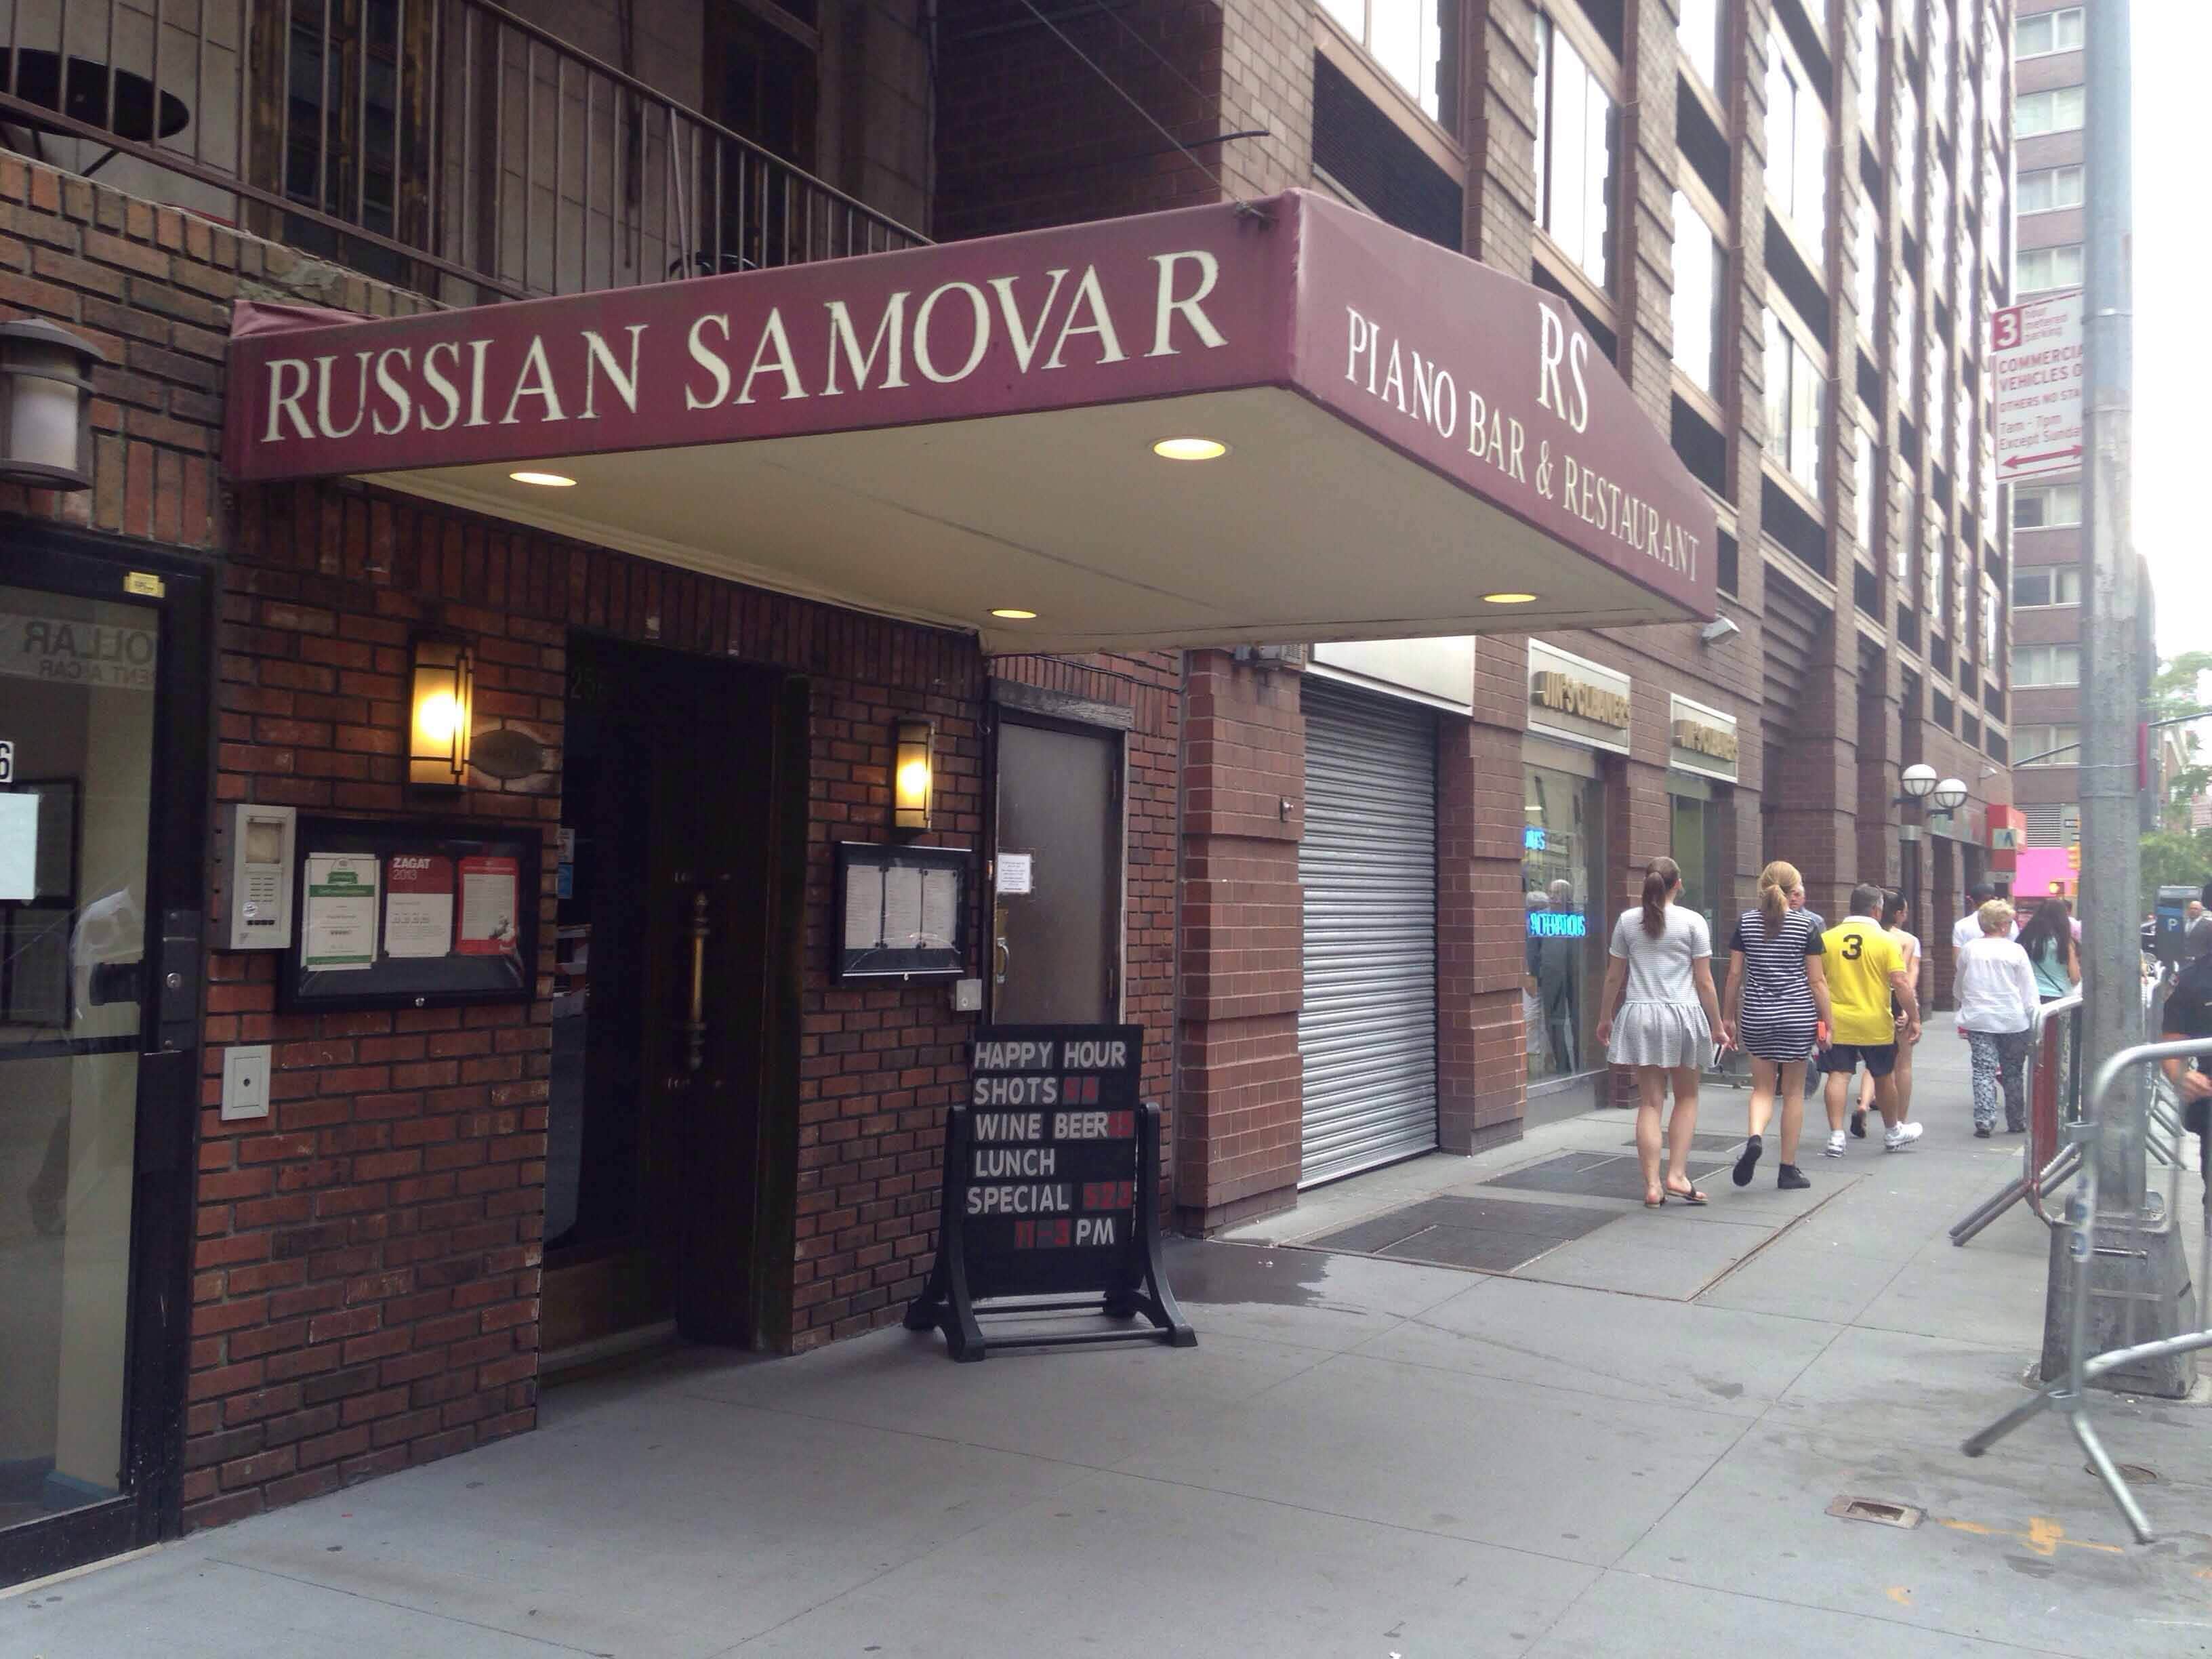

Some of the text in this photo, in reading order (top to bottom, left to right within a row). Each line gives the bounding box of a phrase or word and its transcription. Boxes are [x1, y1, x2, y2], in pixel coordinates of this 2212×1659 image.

[1996, 312, 2017, 347] 3
[261, 250, 1228, 442] RUSSIAN SAMOVAR
[1999, 345, 2082, 374] COMMERCIA
[1537, 302, 1588, 434] RS
[2000, 366, 2068, 392] VEHICLES
[1345, 306, 1700, 582] PIANO BAR & RESTAURANT
[393, 857, 432, 869] ZAGAT
[393, 869, 417, 880] 2013
[2168, 918, 2177, 932] P
[1841, 934, 1863, 960] 3
[974, 1041, 1126, 1069] HAPPY HOUR
[974, 1077, 1058, 1105] SHOTS
[976, 1113, 1042, 1141] WINE
[1054, 1111, 1109, 1139] BEER
[975, 1148, 1054, 1177] LUNCH
[967, 1184, 1069, 1214] SPECIAL
[1076, 1217, 1115, 1246] PM
